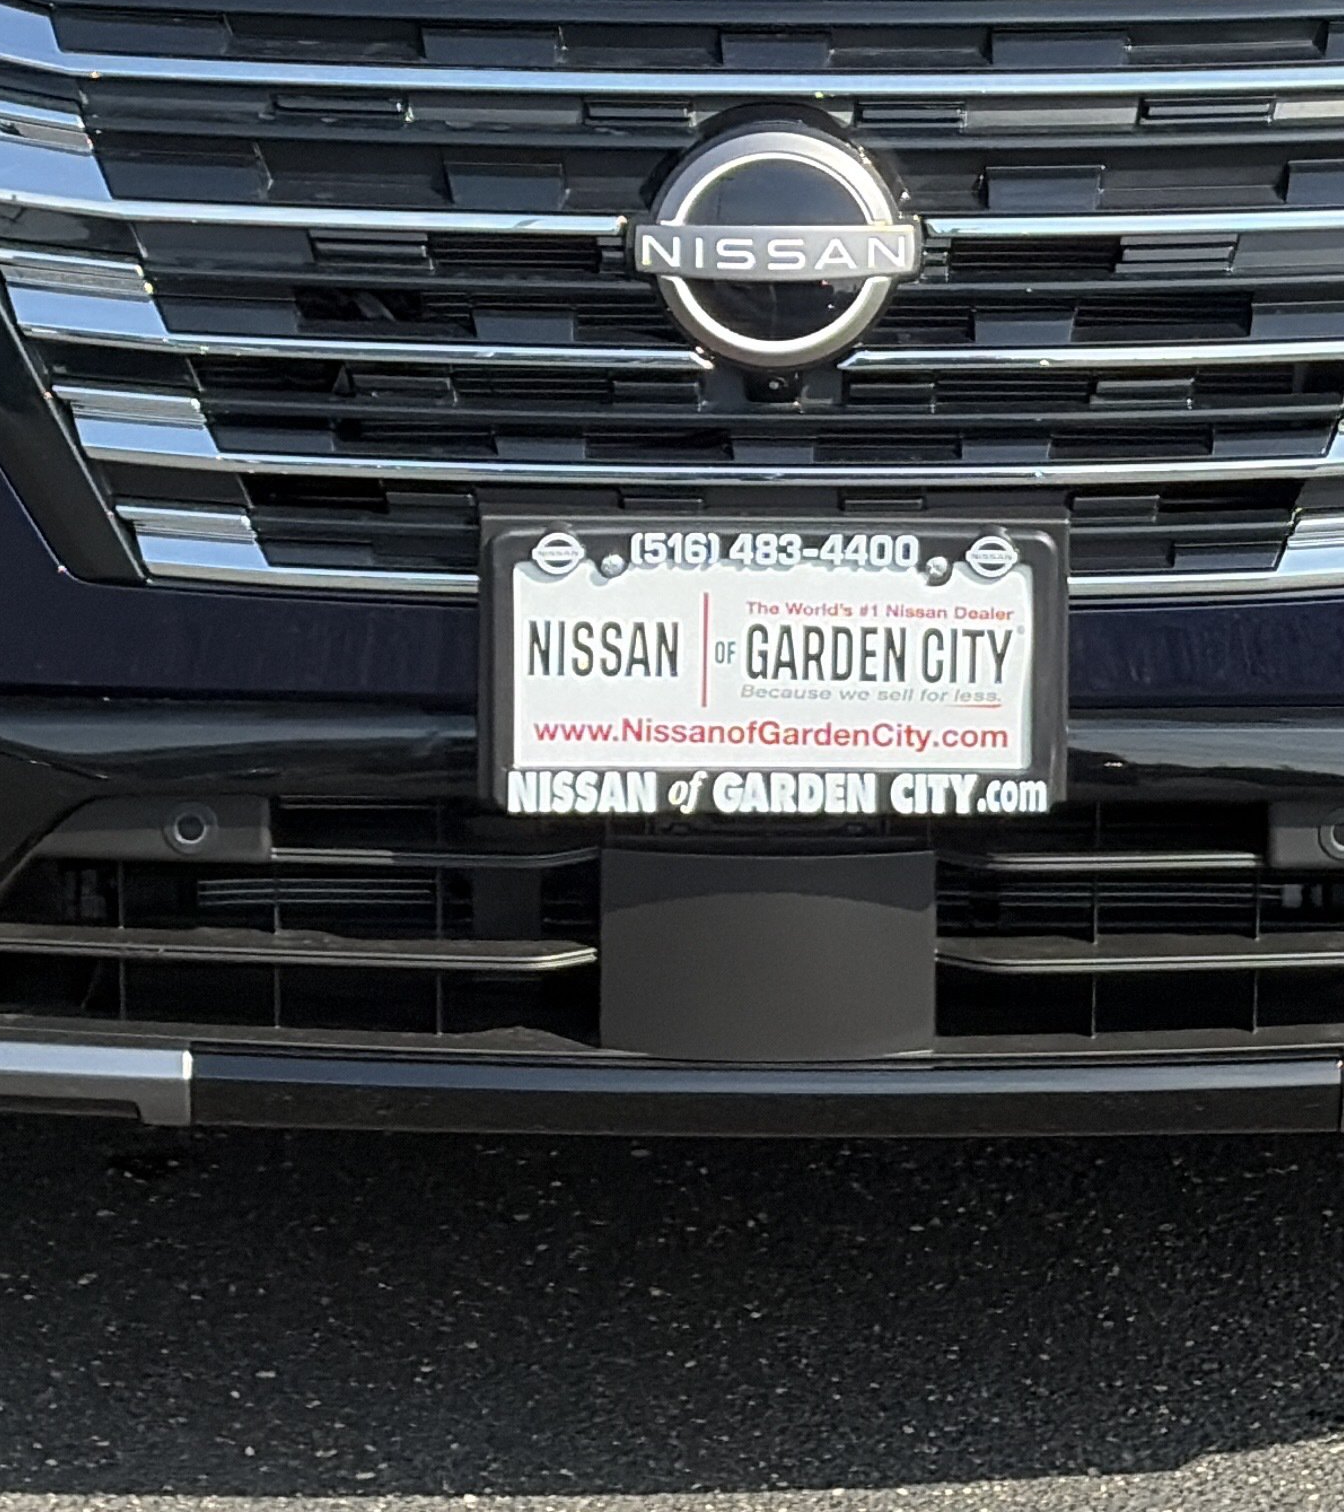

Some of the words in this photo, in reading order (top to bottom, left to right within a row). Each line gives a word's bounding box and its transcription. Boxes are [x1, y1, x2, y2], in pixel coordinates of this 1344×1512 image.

[641, 234, 905, 270] NISSAN
[630, 532, 720, 565] (516)
[729, 532, 919, 567] 483-4400
[746, 601, 780, 616] The
[785, 602, 853, 617] World's
[859, 603, 879, 618] #1
[886, 604, 948, 620] Nissan
[954, 606, 1015, 621] Dealer
[528, 620, 679, 677] NISSAN
[714, 641, 737, 664] OF
[746, 623, 907, 682] GARDEN
[921, 627, 1013, 684] CITY
[741, 684, 831, 701] Because
[839, 689, 868, 701] we
[877, 688, 913, 702] sell
[920, 688, 949, 702] for
[954, 688, 1002, 703] less.
[534, 717, 1009, 753] www.NissanofGardenCity.com
[508, 770, 657, 813] NISSAN
[668, 770, 708, 814] of
[712, 771, 876, 814] GARDEN
